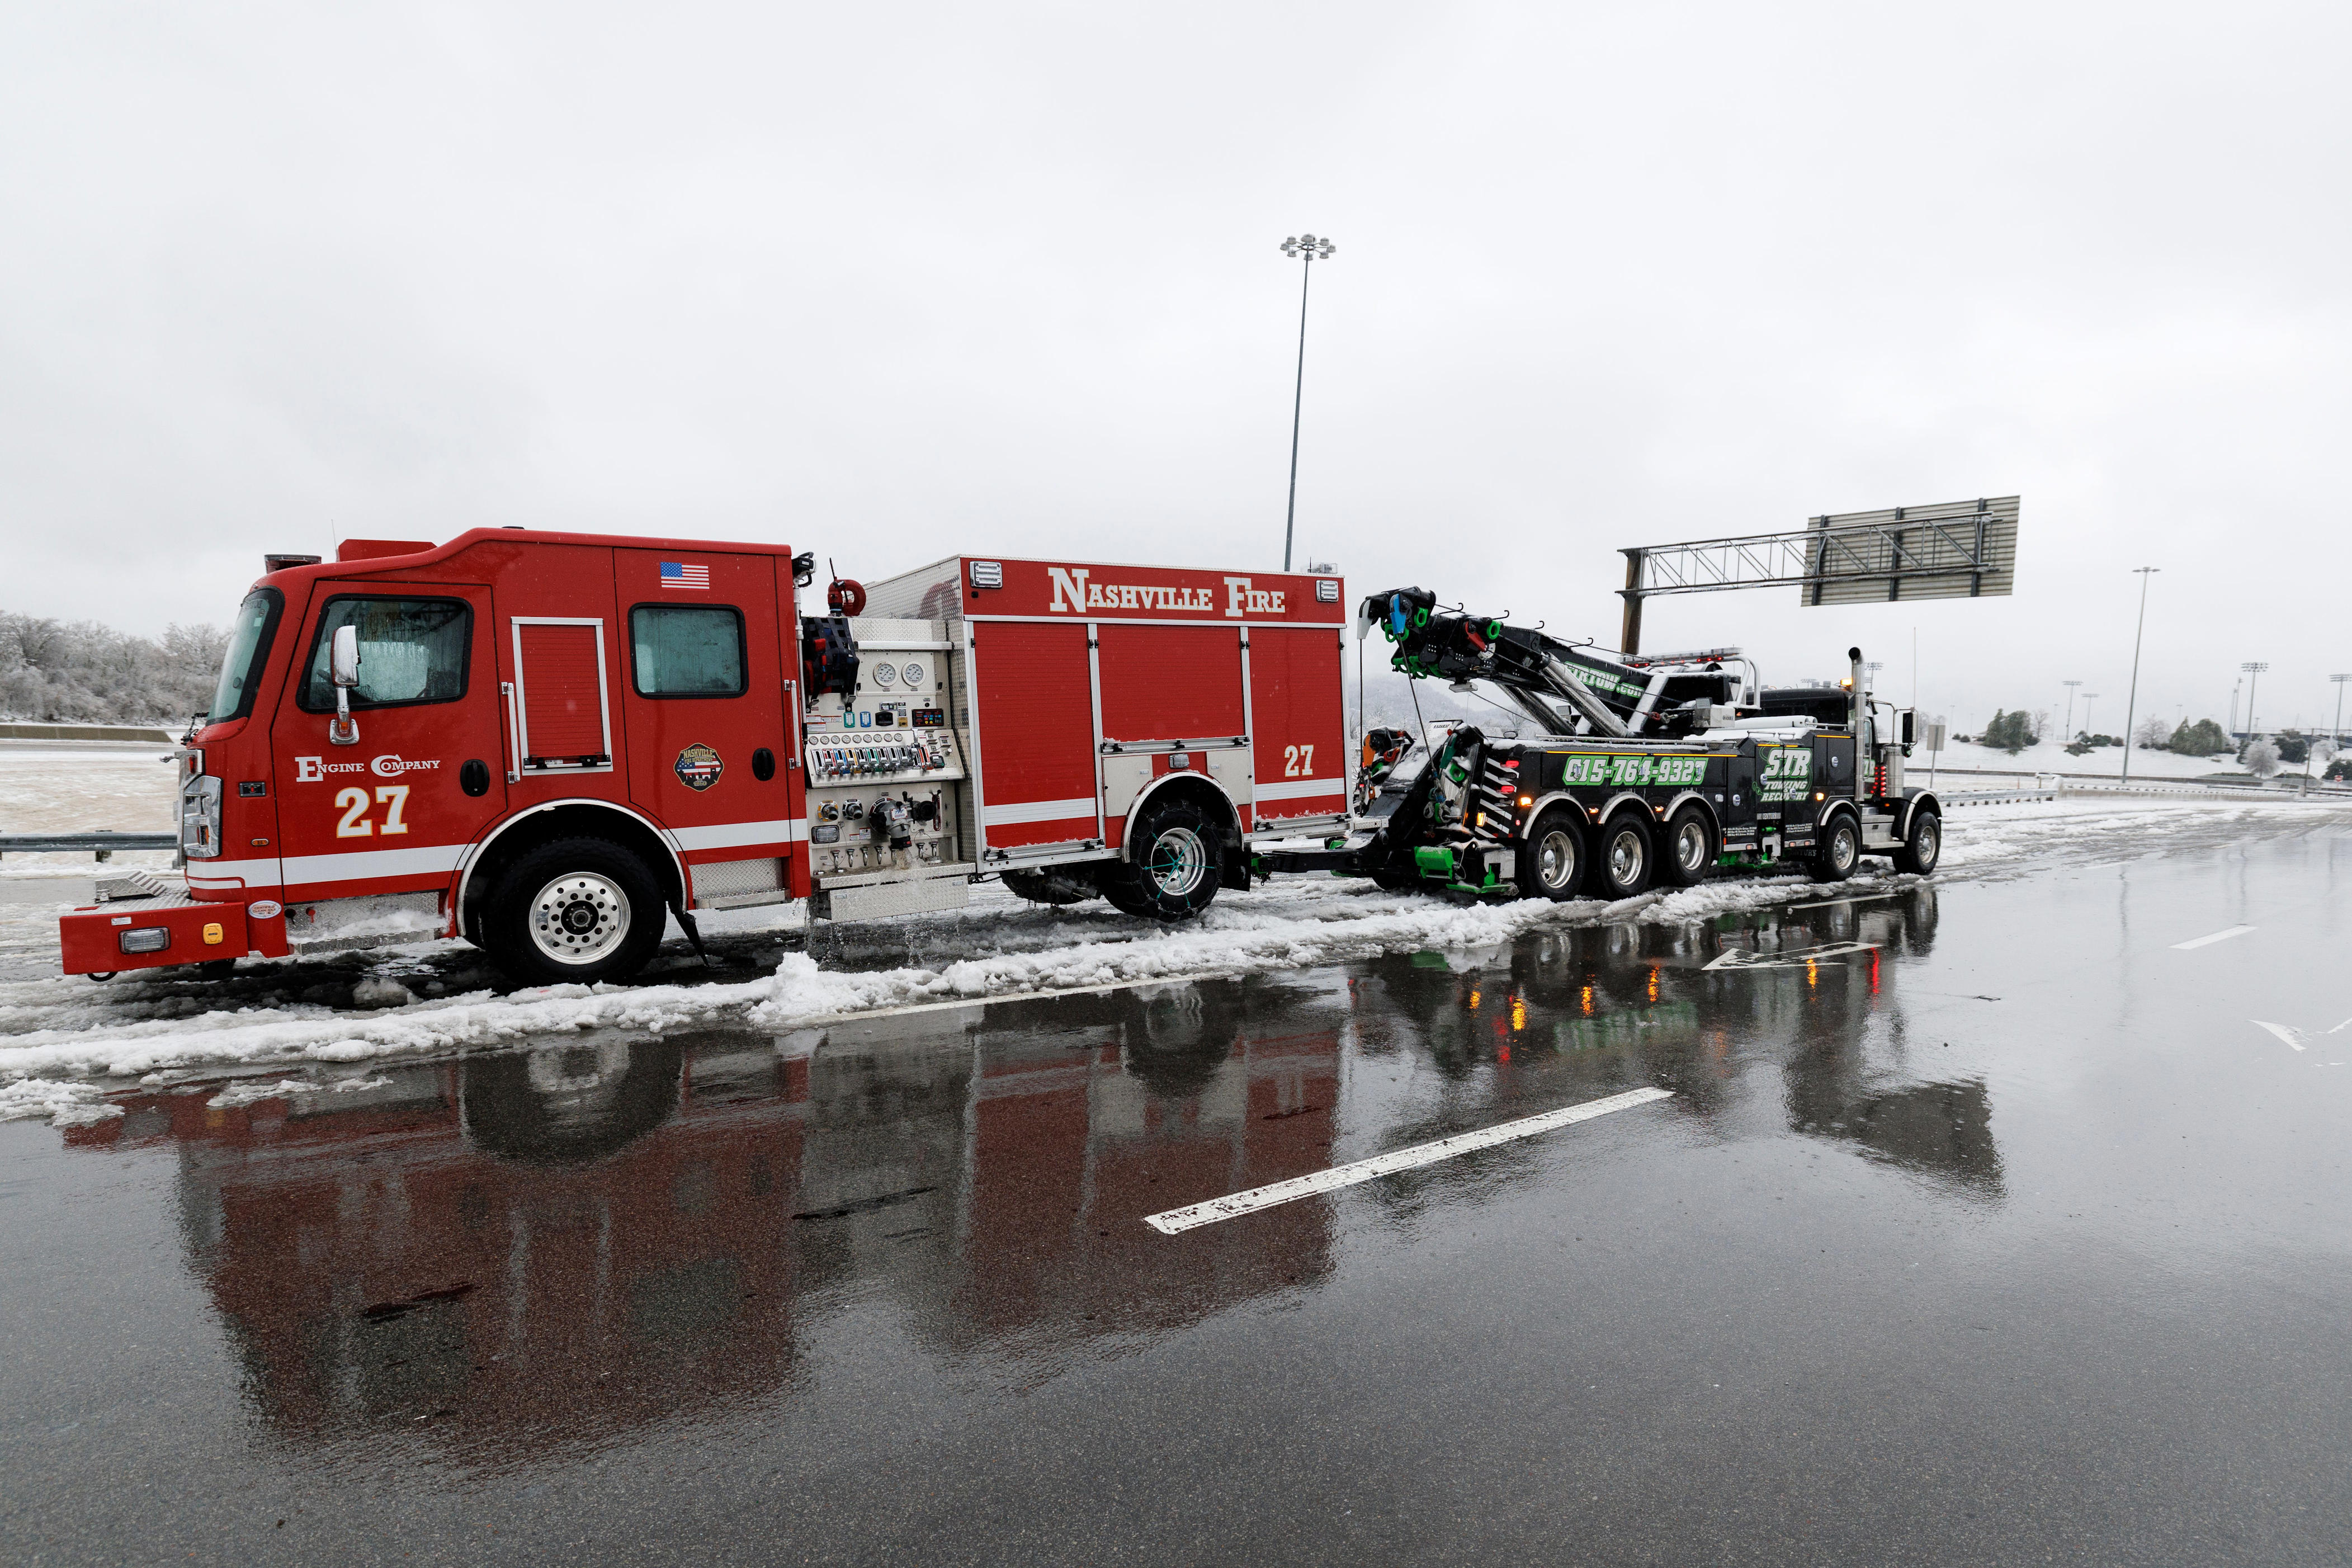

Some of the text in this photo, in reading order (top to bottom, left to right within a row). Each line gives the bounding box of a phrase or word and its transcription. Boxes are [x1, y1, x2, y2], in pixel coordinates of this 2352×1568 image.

[1048, 567, 1285, 617] NASHVILLE FIRE
[295, 754, 441, 782] ENGINE COMPANY
[683, 748, 713, 759] NASHVILLE
[1284, 744, 1314, 777] 27
[1765, 749, 1811, 776] STR
[334, 785, 410, 838] 27
